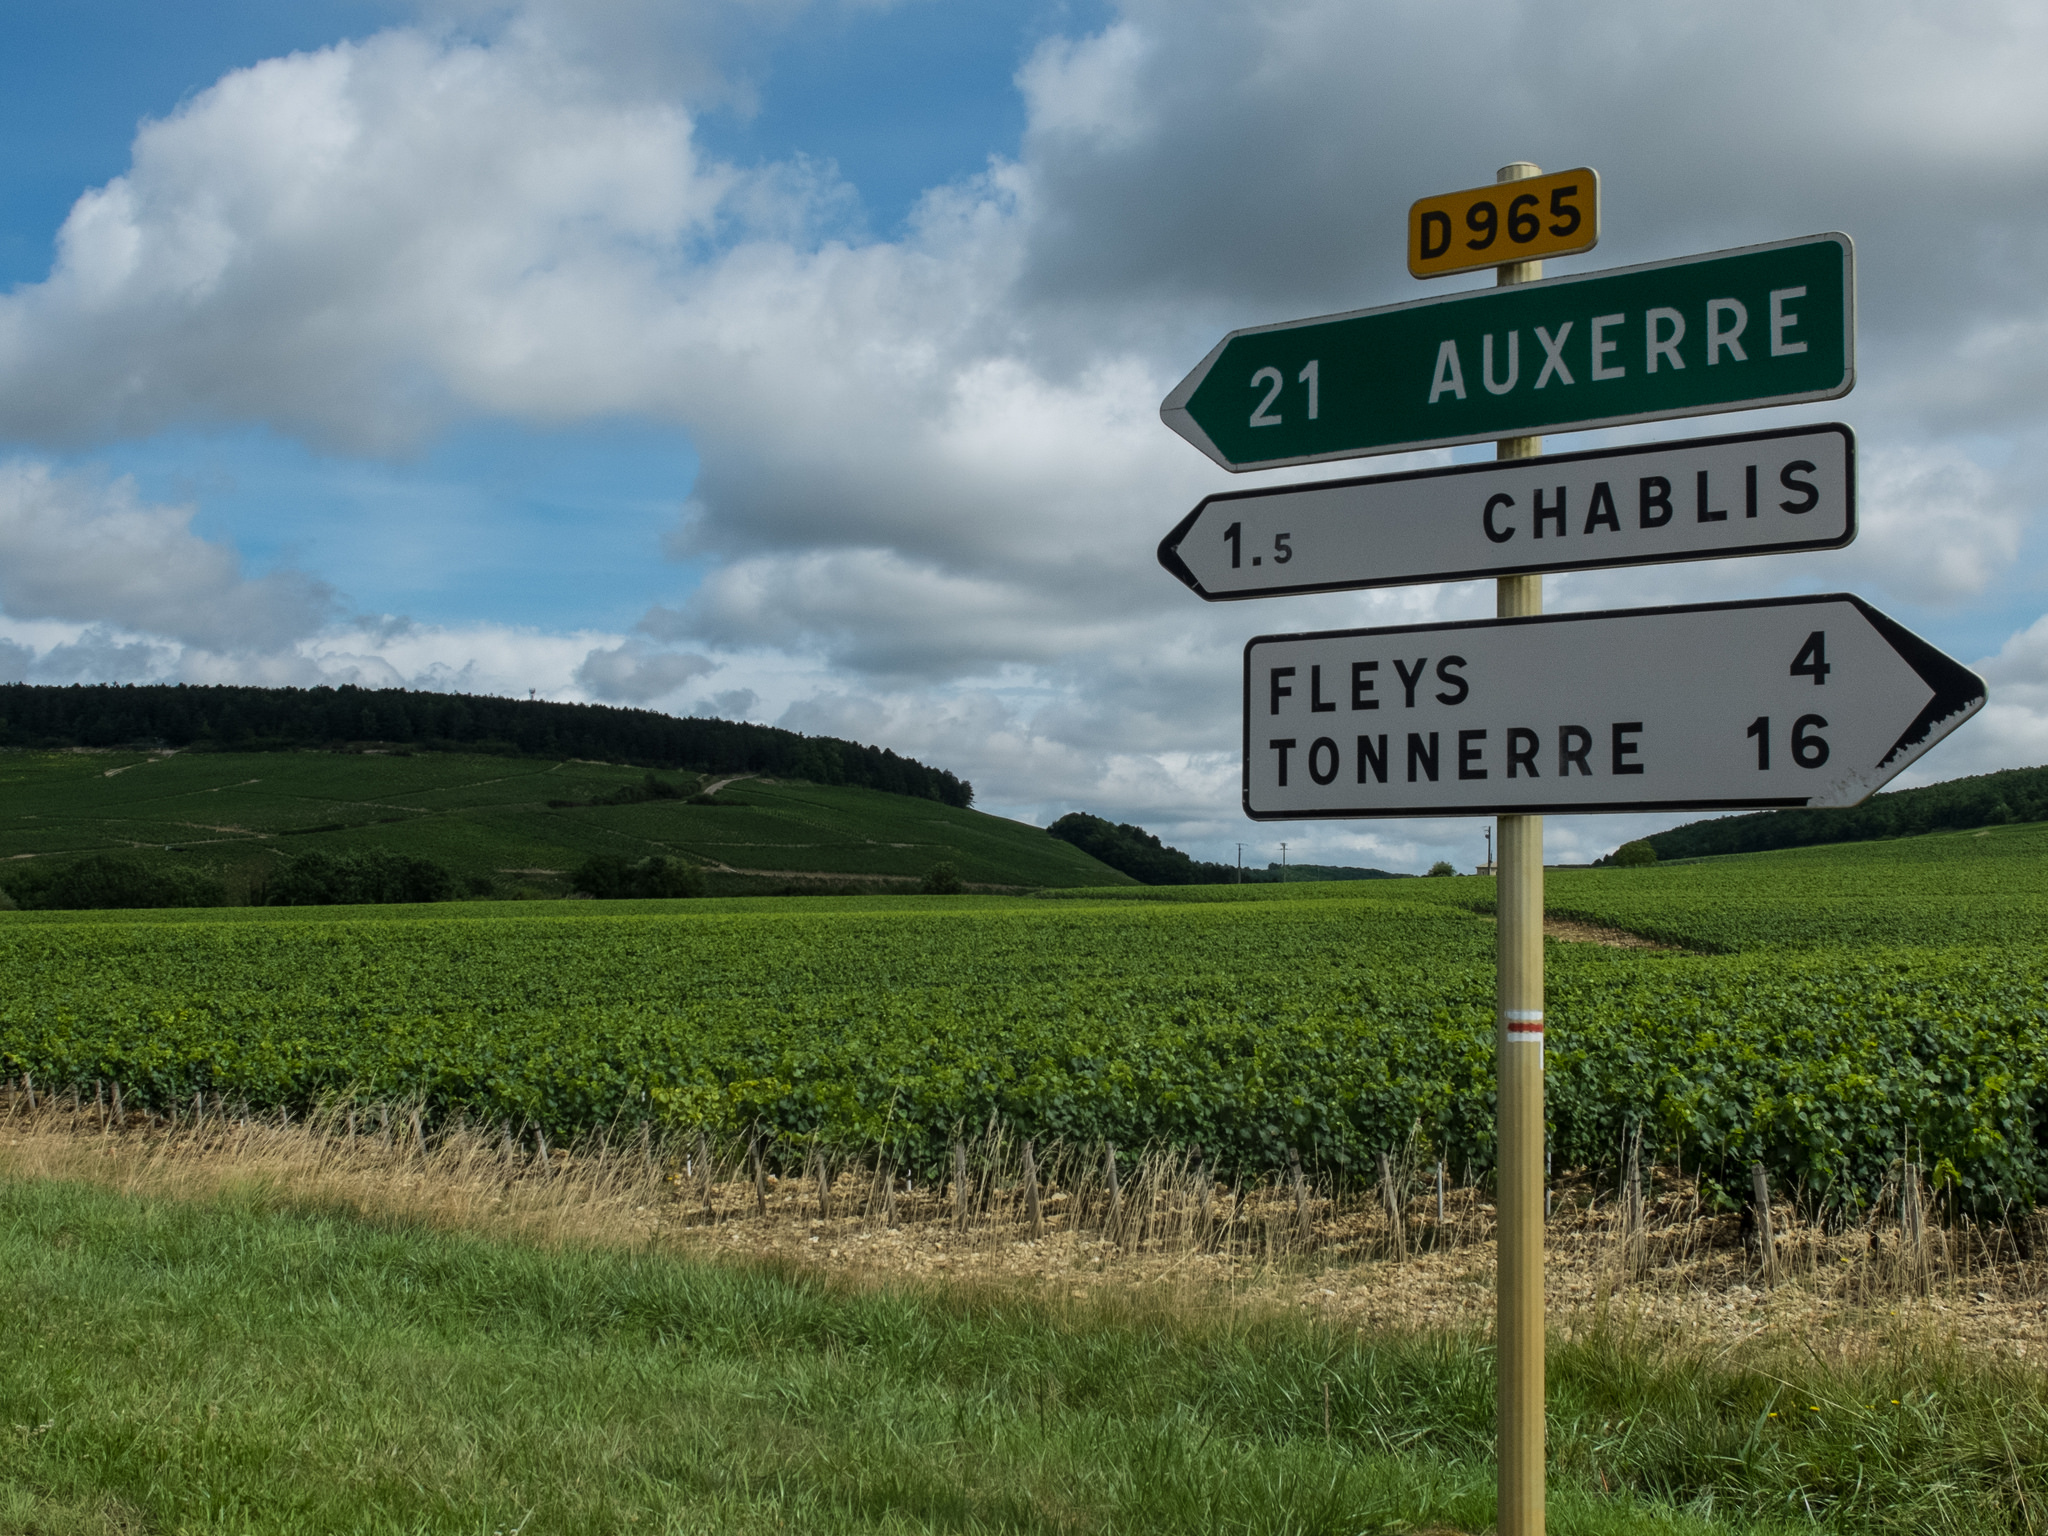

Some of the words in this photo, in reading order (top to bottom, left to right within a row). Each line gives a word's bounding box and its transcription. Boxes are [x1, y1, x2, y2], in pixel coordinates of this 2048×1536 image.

[1249, 359, 1320, 427] 21
[1428, 286, 1809, 404] AUXERRE
[1223, 521, 1293, 569] 1.5
[1482, 460, 1820, 544] CHABLIS
[1269, 654, 1470, 715] FLEYS
[1789, 630, 1830, 686] 4
[1269, 721, 1645, 787] TONNERRE
[1746, 713, 1830, 771] 16
